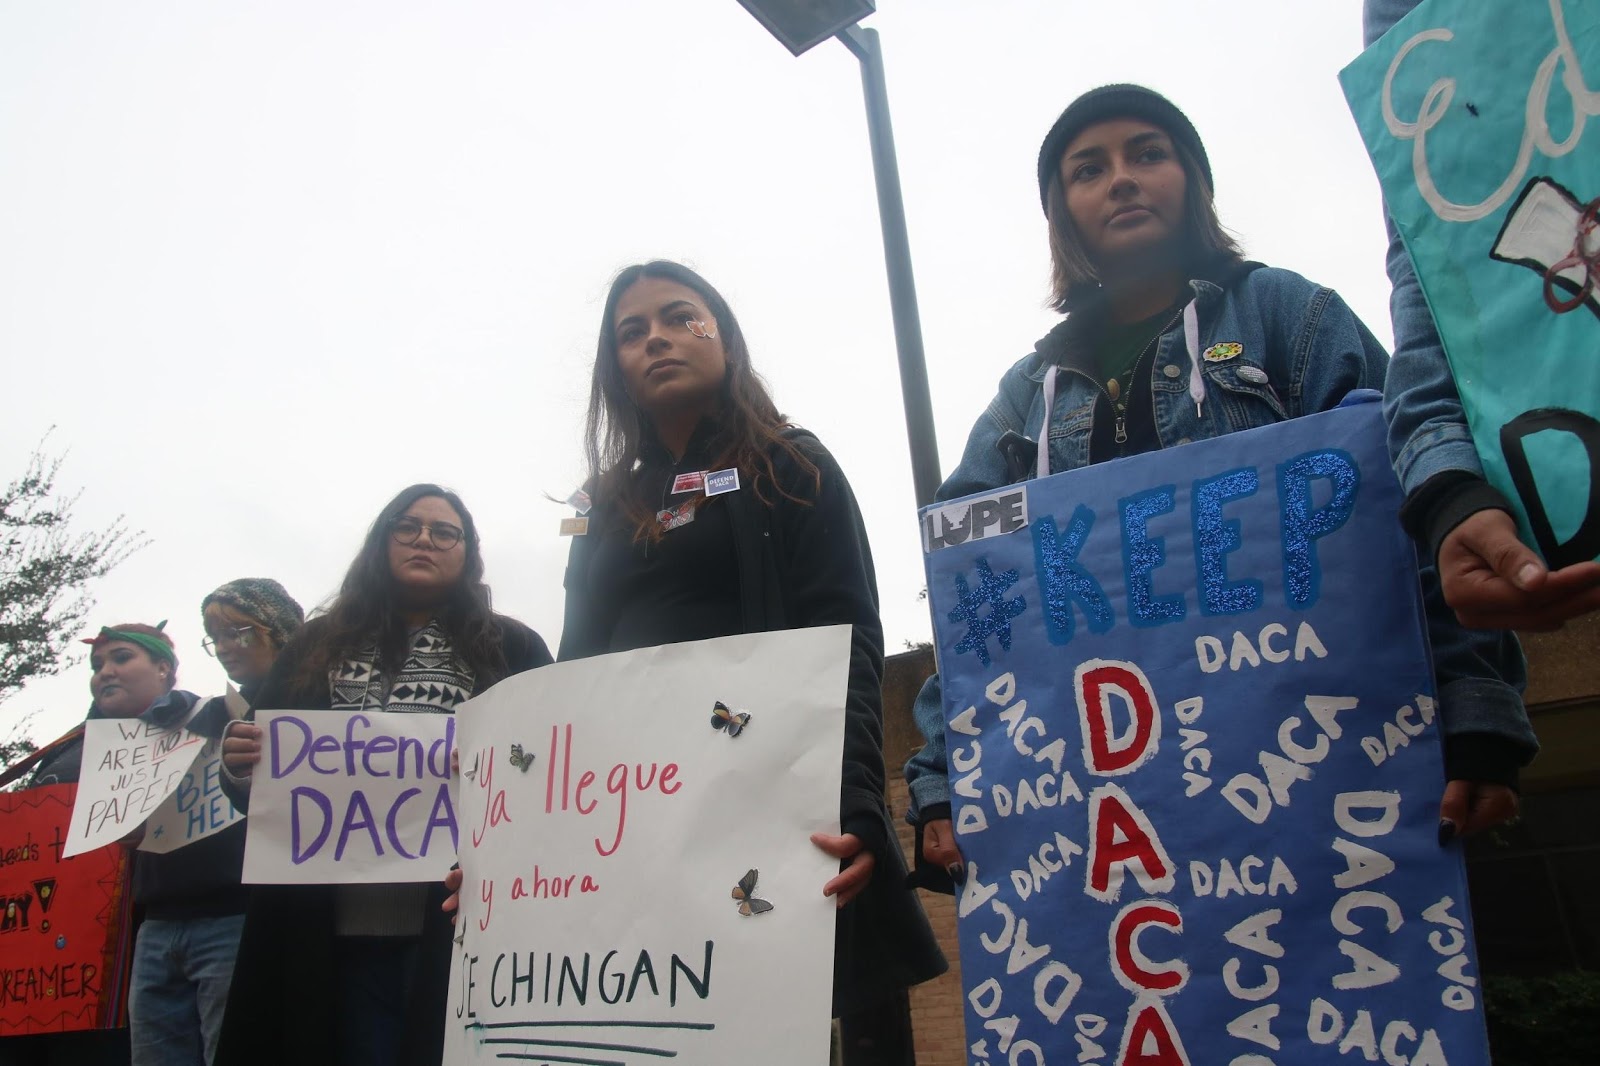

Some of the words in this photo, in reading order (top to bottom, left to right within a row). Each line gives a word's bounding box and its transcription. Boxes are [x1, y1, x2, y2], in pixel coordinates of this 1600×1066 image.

[926, 492, 1024, 550] LUPE
[1195, 621, 1328, 673] DACA
[98, 745, 148, 772] ARE
[156, 731, 198, 756] NO
[269, 714, 455, 780] Defend
[985, 671, 1067, 774] DACA
[1174, 696, 1213, 798] DACA
[1360, 692, 1439, 766] DACA
[111, 759, 166, 791] JUST
[545, 723, 682, 856] llegue
[949, 705, 989, 835] DACA
[992, 770, 1084, 817] DACA
[1220, 694, 1360, 825] DACA
[48, 827, 74, 863] t
[187, 794, 235, 839] HE
[290, 783, 459, 865] DACA
[1011, 831, 1084, 901] DACA
[1074, 657, 1193, 1066] DACA
[1189, 854, 1298, 898] DACA
[1330, 790, 1404, 990] DACA
[480, 879, 494, 931] y
[511, 865, 600, 900] ahora
[959, 861, 1083, 1025] DACA
[1420, 896, 1478, 1012] DACA
[0, 962, 101, 1008] REAMER
[456, 952, 478, 1019] SE
[490, 940, 714, 1008] CHINGAN
[1074, 1013, 1109, 1066] DA
[1307, 997, 1448, 1066] DACA
